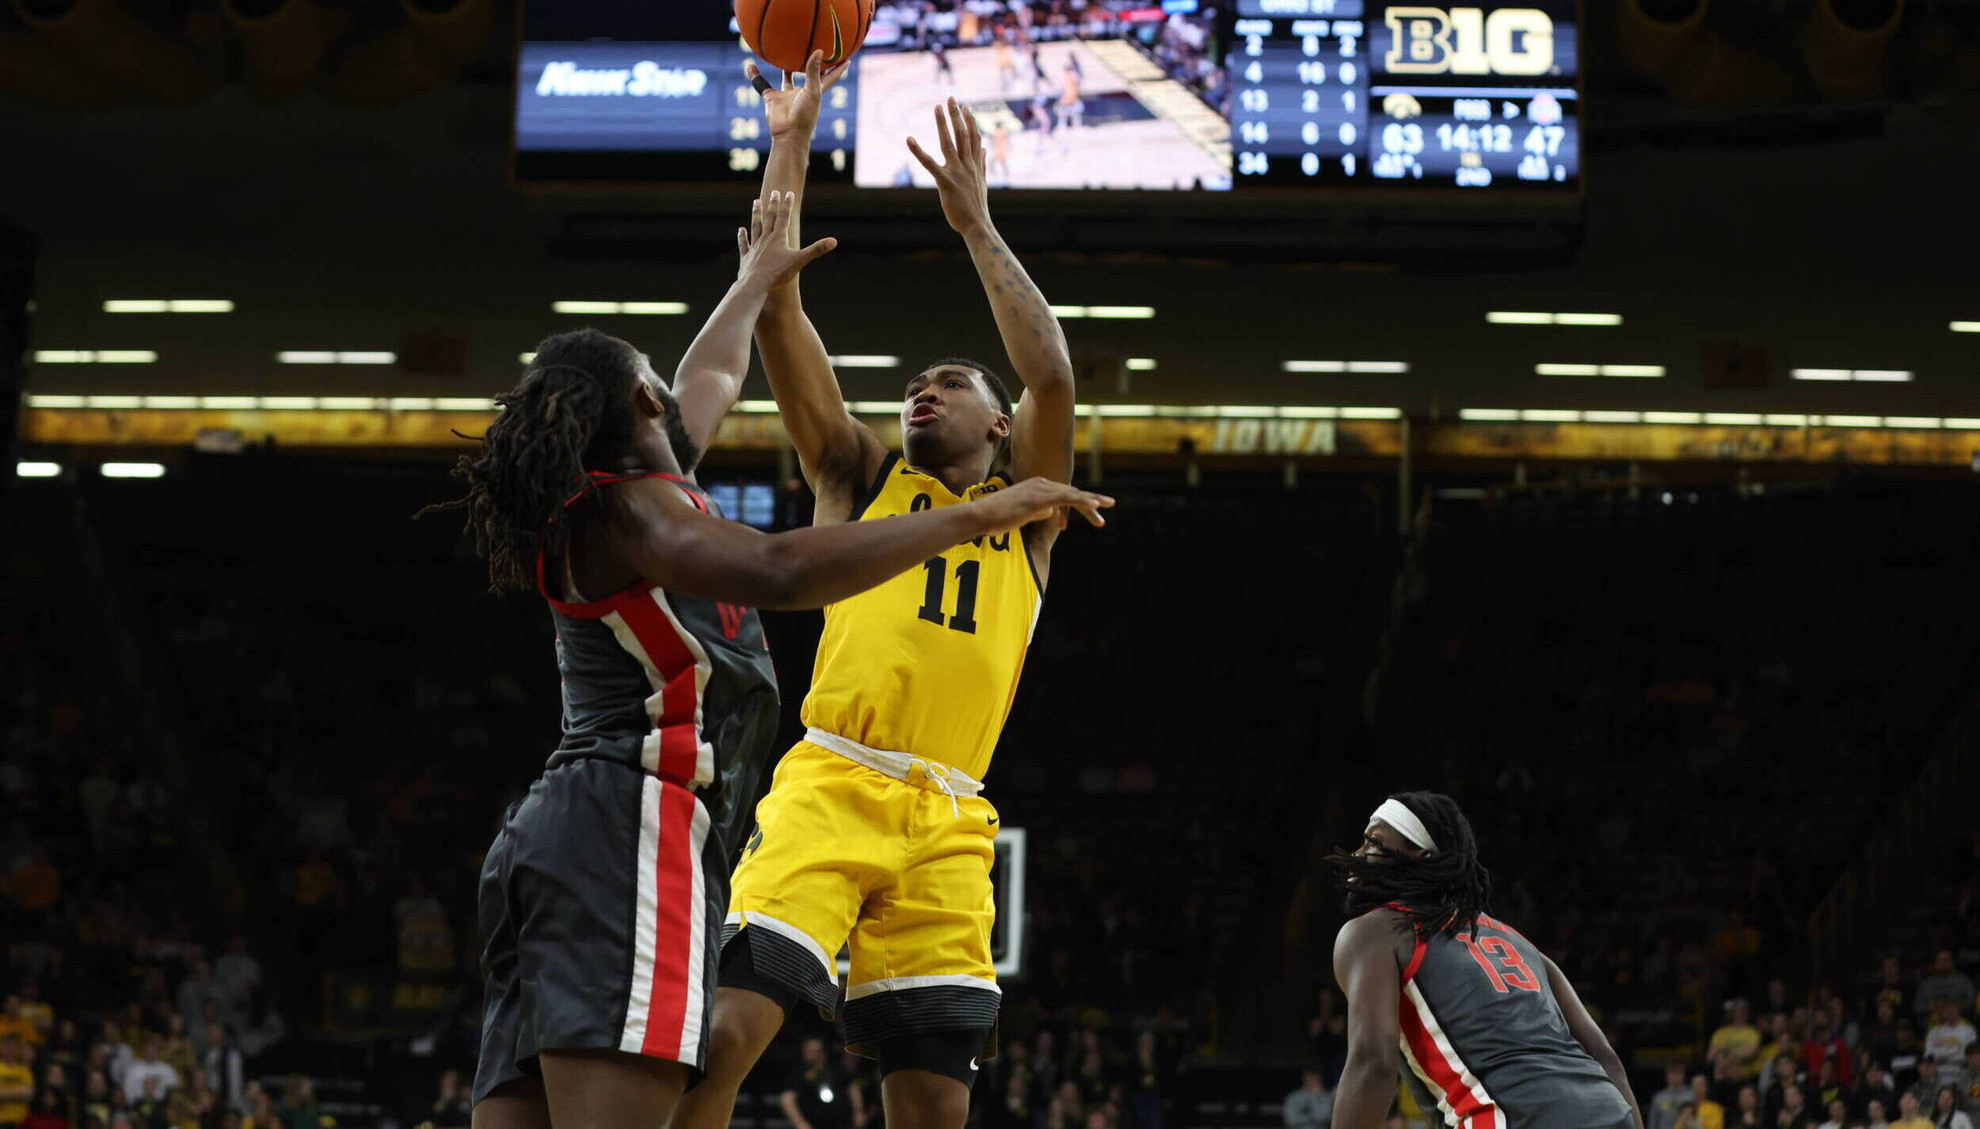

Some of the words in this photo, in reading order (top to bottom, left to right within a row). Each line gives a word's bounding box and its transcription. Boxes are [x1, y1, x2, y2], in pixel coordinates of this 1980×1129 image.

[1245, 61, 1263, 83] 4
[1342, 90, 1355, 113] 1
[833, 118, 847, 140] 1
[1383, 123, 1424, 154] 63
[1437, 124, 1513, 151] 14:12
[1524, 125, 1565, 155] 47
[832, 149, 846, 172] 1
[1342, 153, 1355, 176] 1
[1212, 418, 1335, 455] IOWA
[918, 556, 980, 635] 11
[1456, 933, 1541, 994] 13
